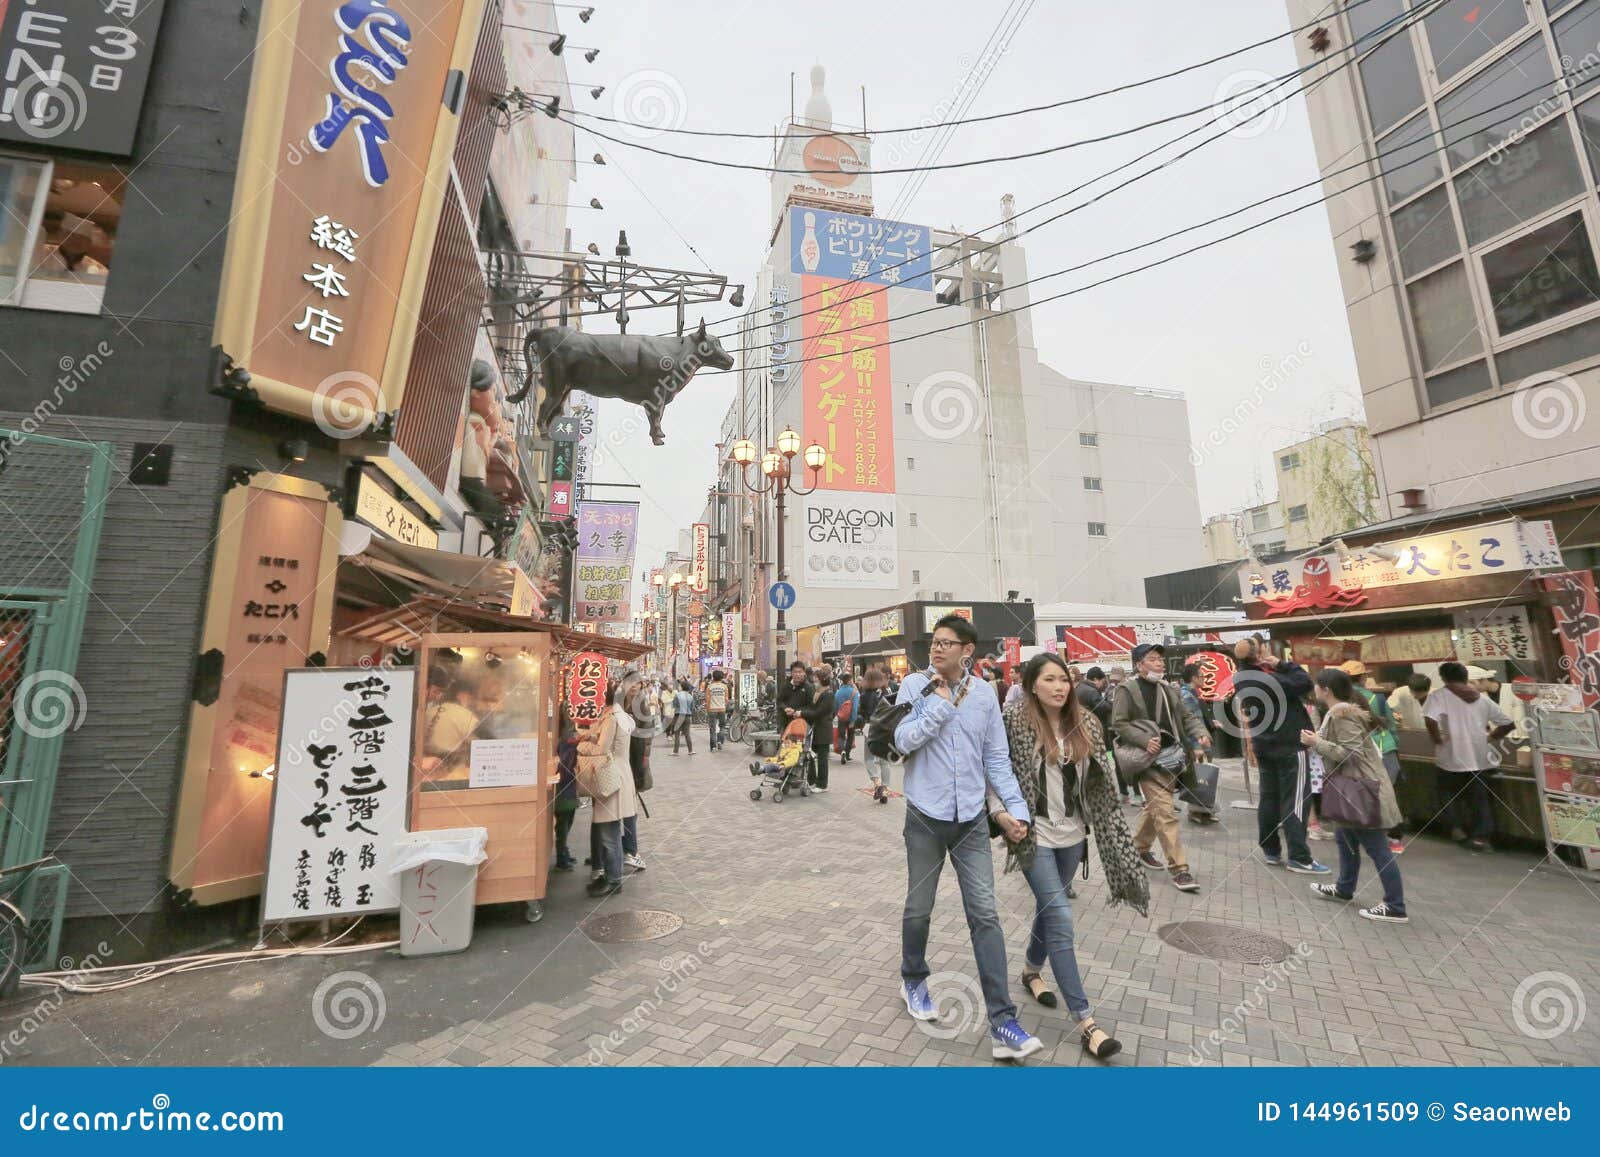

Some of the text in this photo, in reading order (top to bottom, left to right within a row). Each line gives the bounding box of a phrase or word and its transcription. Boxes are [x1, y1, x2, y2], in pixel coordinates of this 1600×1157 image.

[828, 217, 921, 246] ボウリング
[828, 237, 921, 266] ビリヤード
[293, 213, 360, 348] 総本店
[816, 281, 847, 484] ドラゴンゲート
[553, 491, 568, 505] 酒
[583, 509, 634, 527] 天ぷら
[808, 507, 894, 528] DRAGON
[589, 529, 627, 554] 久幸
[808, 525, 862, 544] GATE
[1406, 537, 1505, 576] 大たこ
[576, 658, 601, 720] たこ焼
[300, 743, 342, 838] どうぞ
